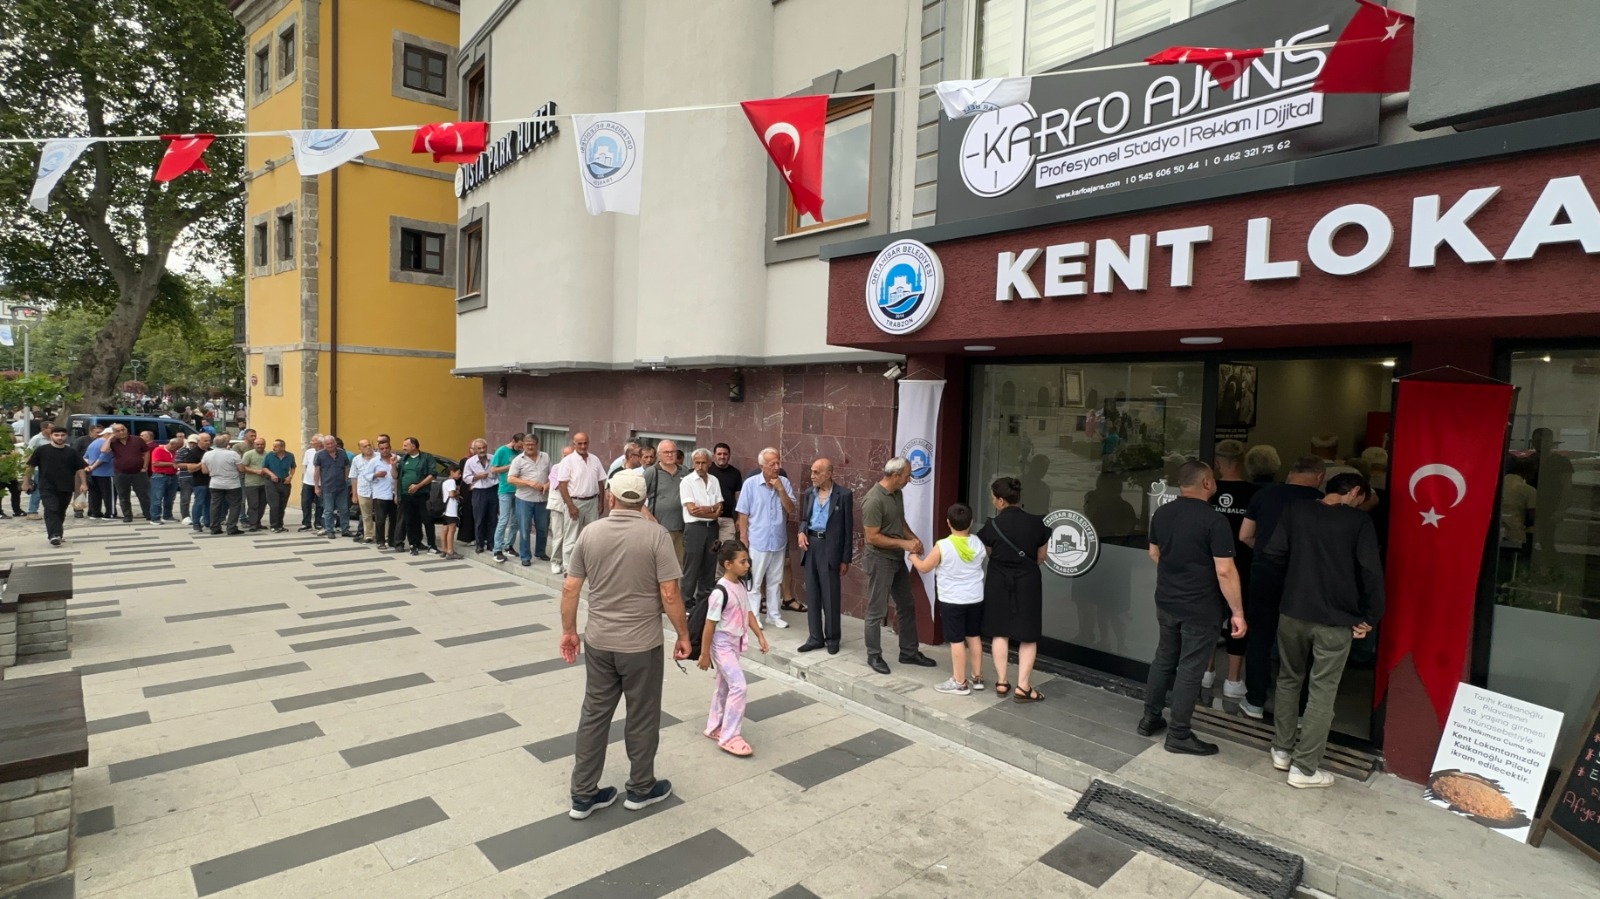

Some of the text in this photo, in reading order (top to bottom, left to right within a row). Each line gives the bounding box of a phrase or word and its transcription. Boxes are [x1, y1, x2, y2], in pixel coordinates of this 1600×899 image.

[488, 131, 513, 175] PARK
[517, 101, 555, 155] HOTEL
[1040, 97, 1314, 179] Profesyonel Stüdyo Reklam Dijital
[1055, 140, 1291, 200] www.karfoajans.com 0 545 606 50 44 0 462 321 75 62
[996, 175, 1600, 301] KENT LOKA
[886, 318, 914, 328] TRABZON
[1463, 706, 1546, 739] 168 yaşına girmesi
[1474, 693, 1544, 720] Tarihi Kalkanoğlu
[1452, 731, 1540, 768] Kent Lokantamızda
[1453, 721, 1546, 758] Tüm halkımıza Cuma günü
[1468, 718, 1533, 745] münasebetiyle
[1451, 749, 1530, 784] ikram edilecektir.
[1454, 741, 1532, 775] Kalkanoğlu Pilavı
